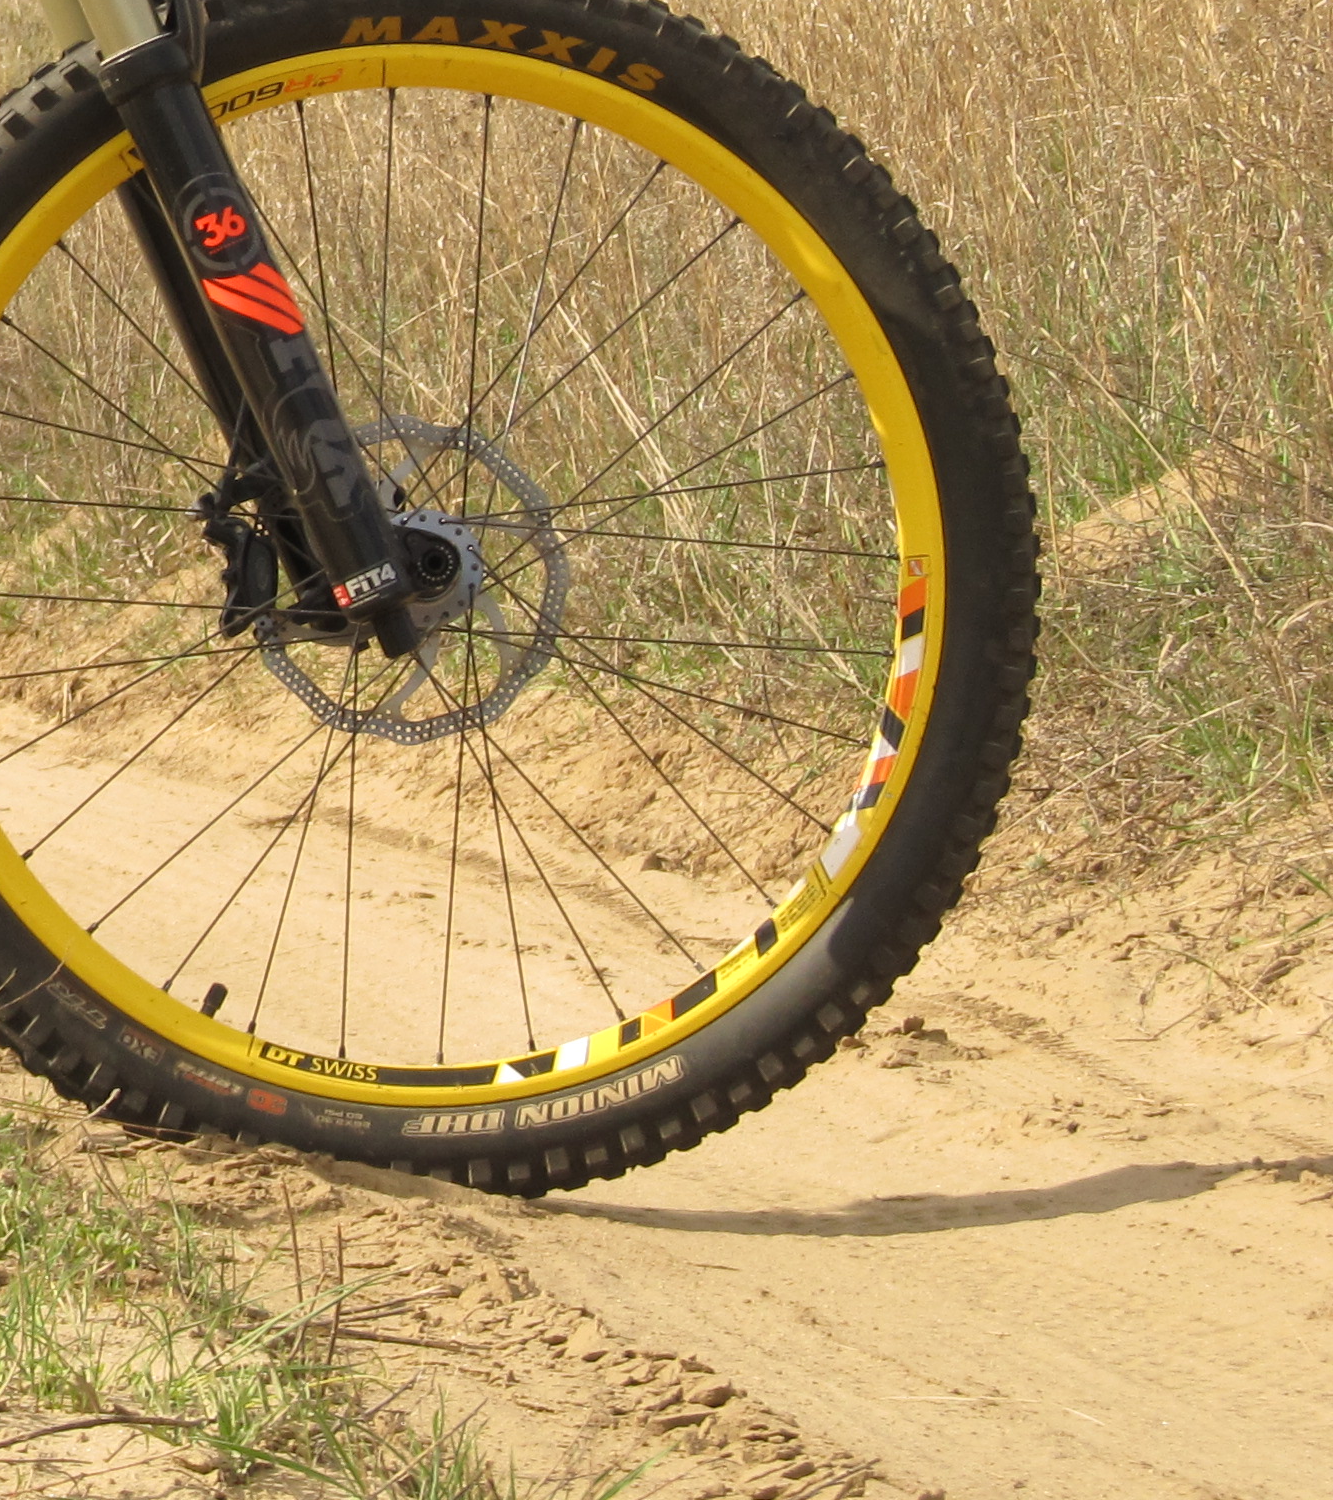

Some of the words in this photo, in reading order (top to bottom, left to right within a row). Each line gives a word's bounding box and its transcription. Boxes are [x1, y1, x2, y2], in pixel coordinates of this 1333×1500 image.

[340, 15, 666, 93] MAXXIS
[194, 205, 247, 248] 36
[265, 1048, 306, 1068] DT
[309, 1056, 379, 1082] SWISS
[514, 1054, 684, 1130] MINION
[401, 1108, 506, 1137] DHF
